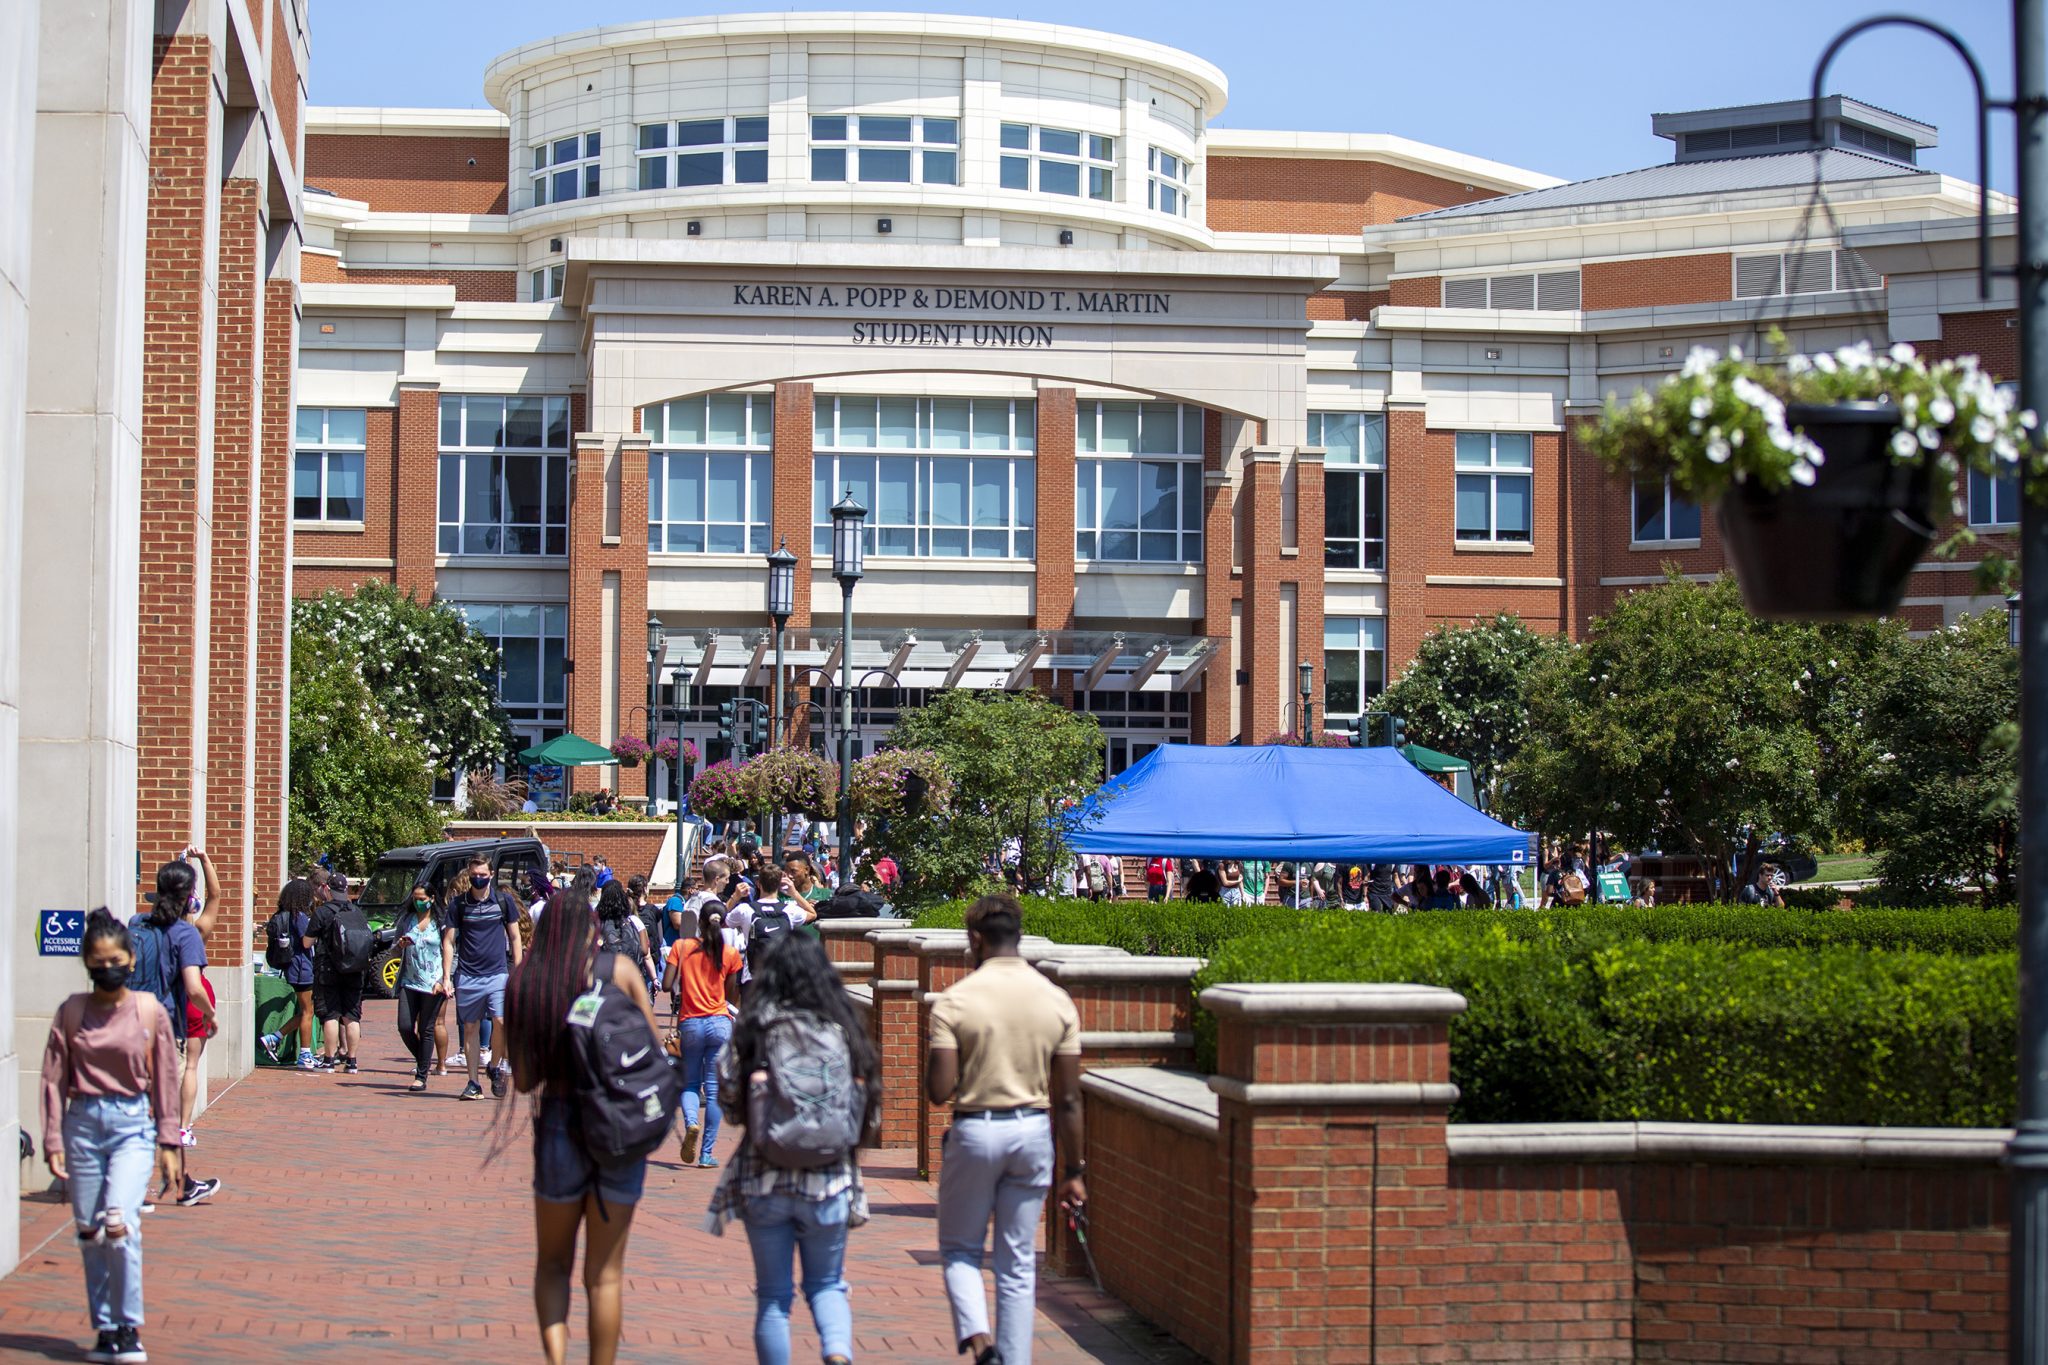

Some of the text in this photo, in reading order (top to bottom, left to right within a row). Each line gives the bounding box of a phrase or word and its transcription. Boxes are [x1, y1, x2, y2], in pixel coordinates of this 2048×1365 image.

[733, 285, 1171, 314] KAREN A. POPP & DEMOND T. MARTIN
[852, 322, 1055, 347] STUDENT UNION
[43, 937, 81, 945] ACCESSIBLE
[45, 945, 79, 953] ENTRANCE
